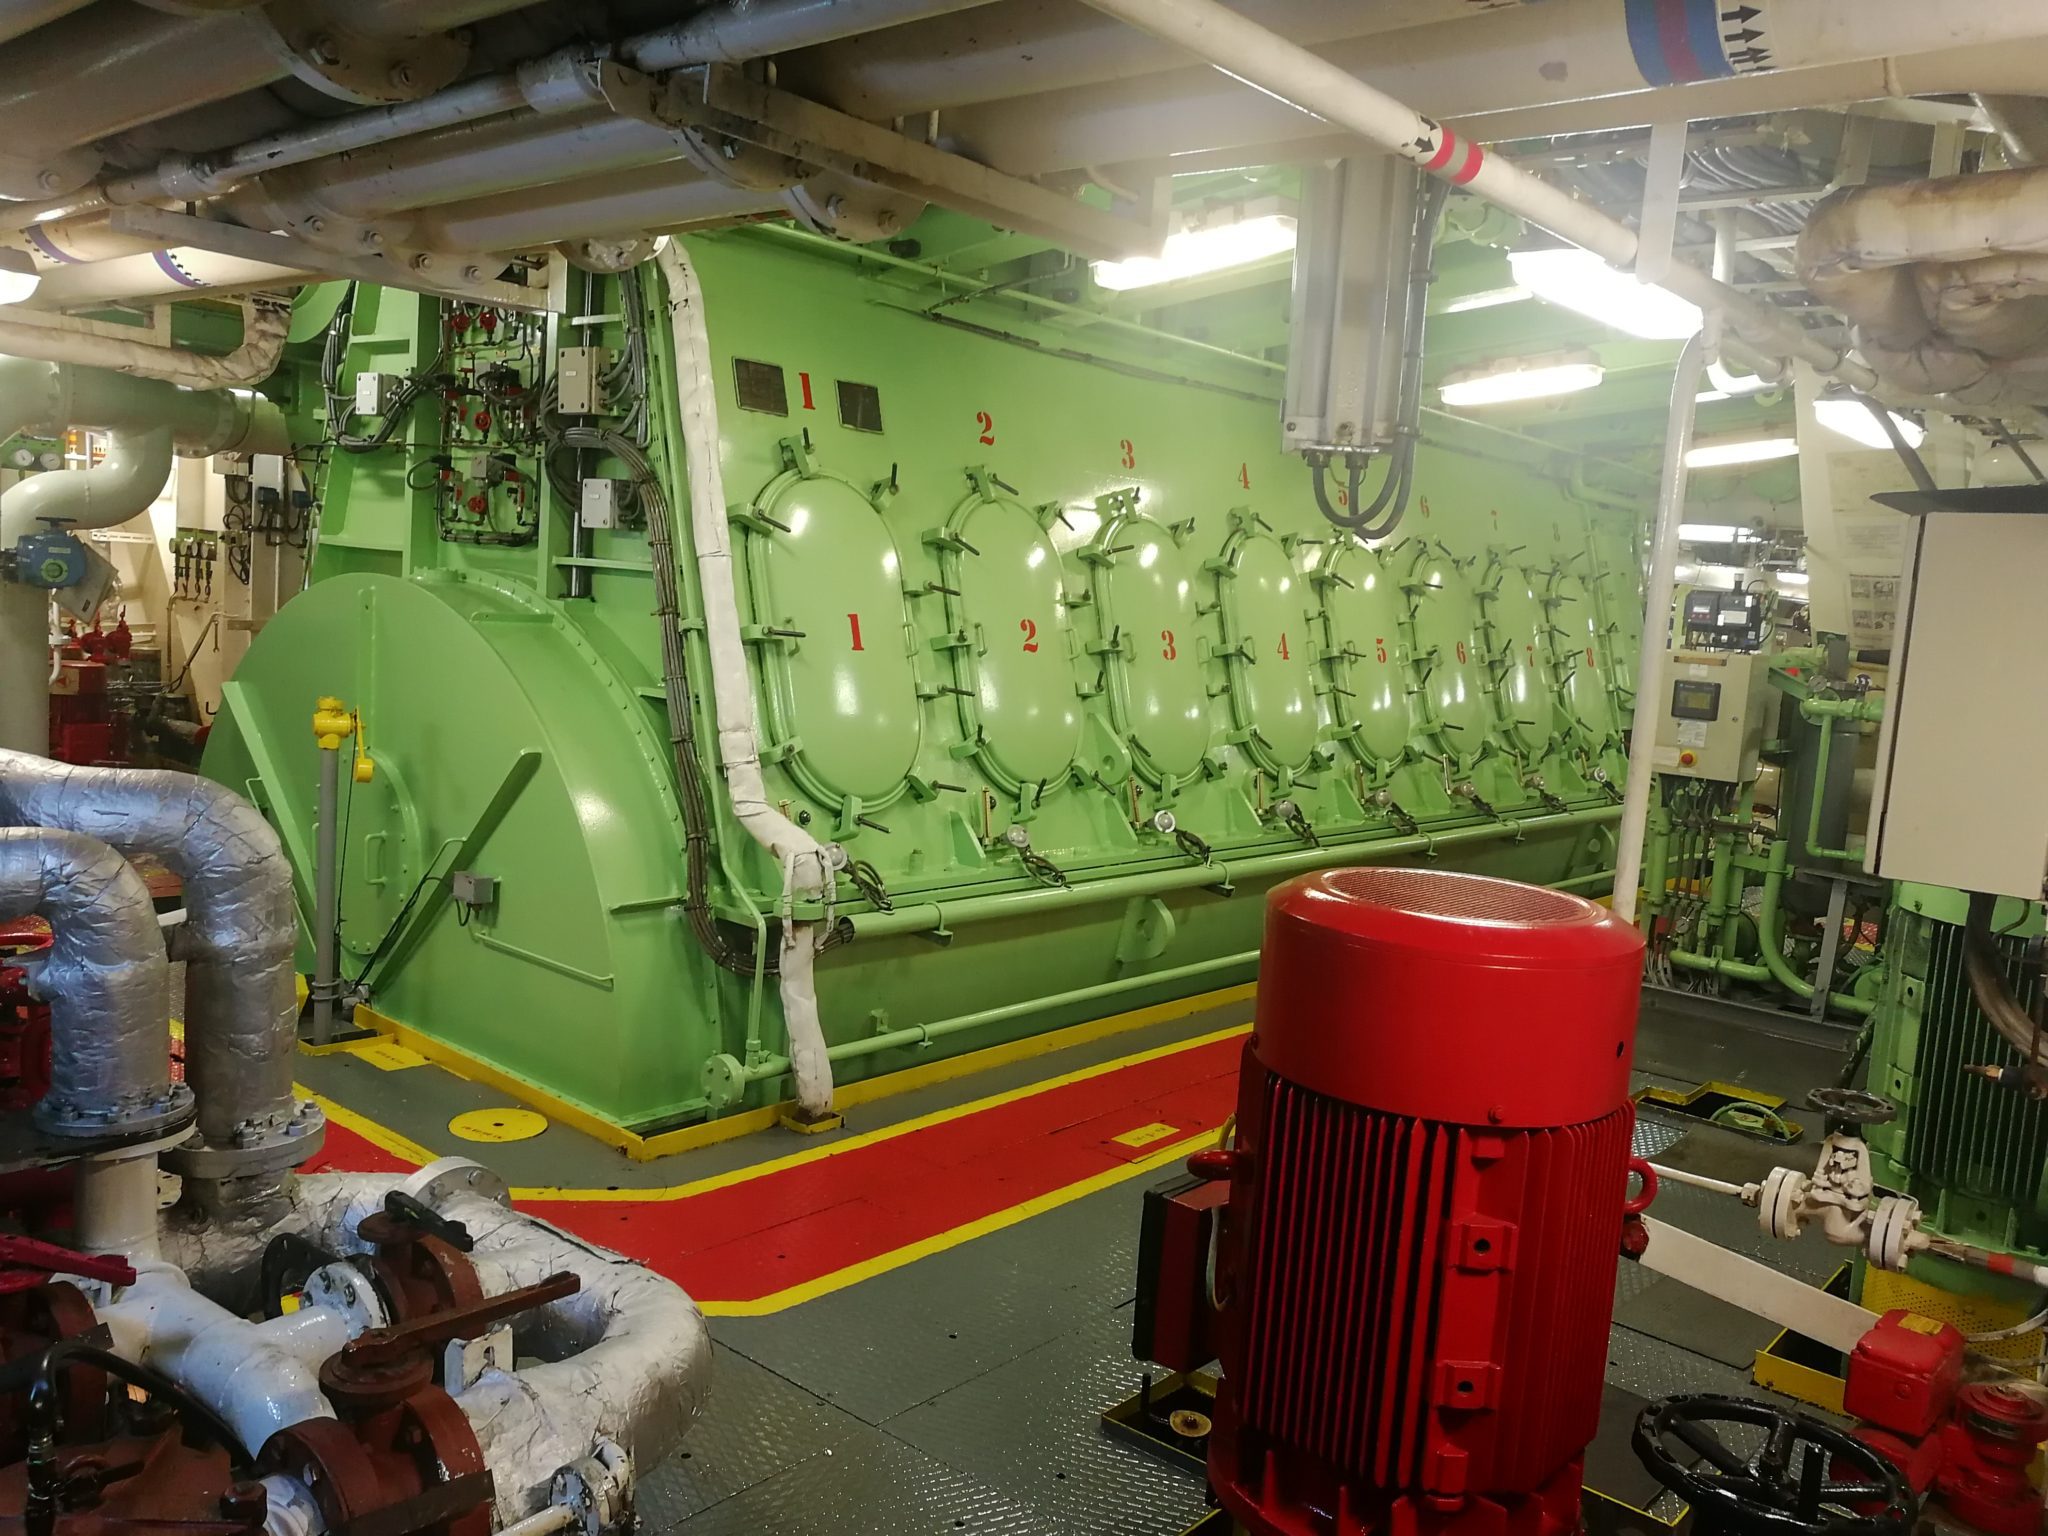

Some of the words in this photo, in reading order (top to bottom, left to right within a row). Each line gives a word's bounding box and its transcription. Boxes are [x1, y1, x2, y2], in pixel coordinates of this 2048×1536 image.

[799, 372, 815, 410] 1
[977, 411, 995, 446] 2
[1120, 439, 1135, 469] 3
[1238, 462, 1250, 490] 4
[1419, 495, 1430, 519] 6
[847, 613, 864, 651] 1
[1020, 619, 1038, 653] 2
[1161, 630, 1176, 660] 3
[1277, 632, 1290, 660] 4
[1376, 638, 1387, 663] 5
[1456, 641, 1466, 664] 6
[1526, 645, 1534, 667] 7
[1586, 647, 1595, 667] 8
